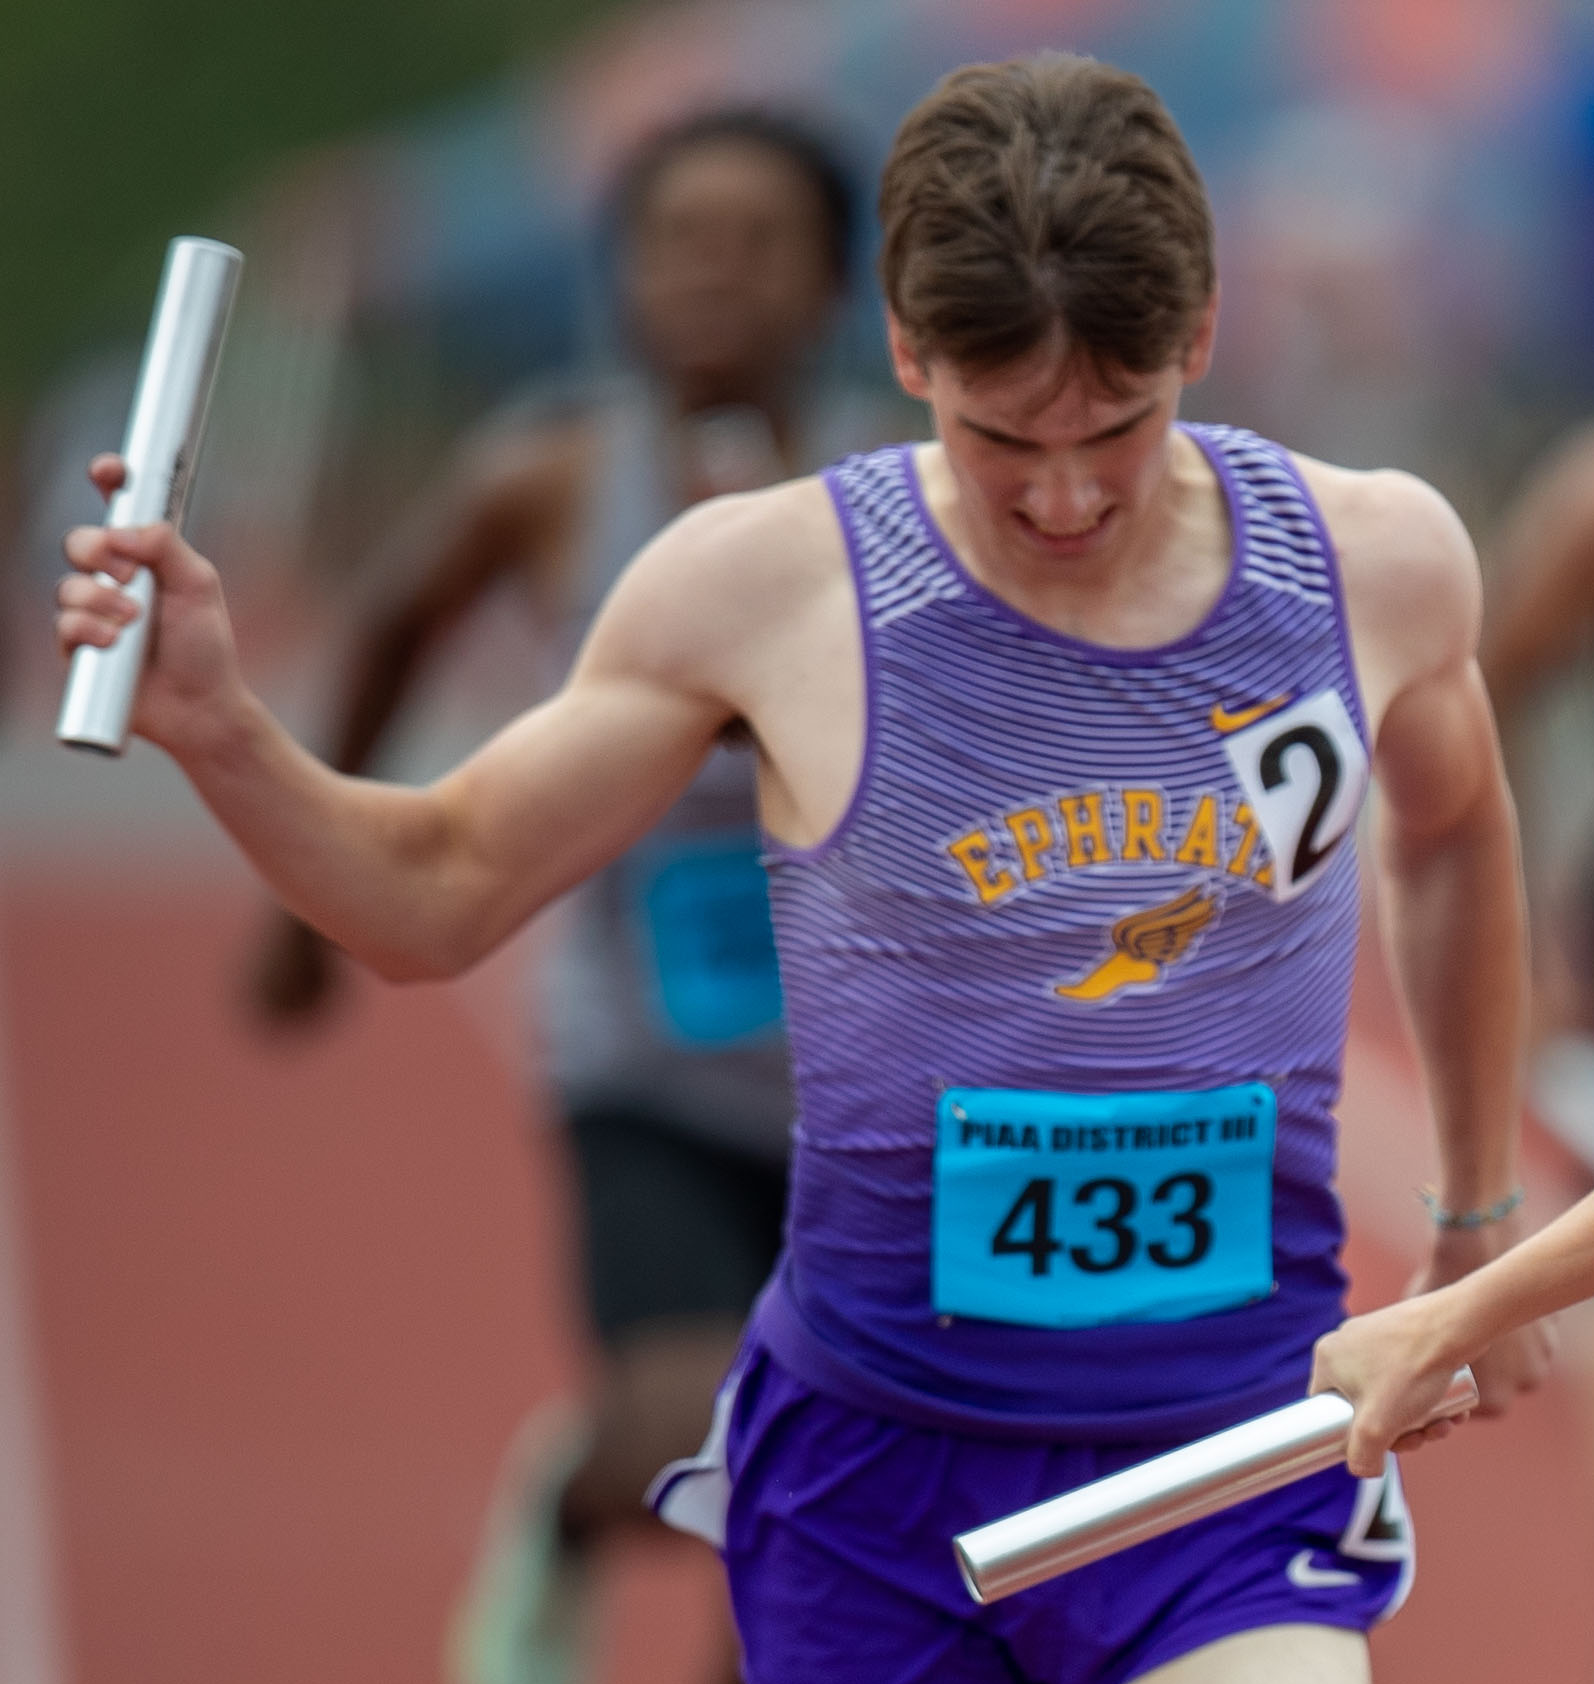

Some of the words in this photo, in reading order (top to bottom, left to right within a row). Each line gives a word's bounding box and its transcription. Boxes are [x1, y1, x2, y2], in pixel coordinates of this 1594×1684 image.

[947, 789, 1275, 905] EPHRAT
[1260, 725, 1350, 884] 2
[960, 1121, 1039, 1150] PIAA
[1052, 1119, 1213, 1151] DISTRICT
[1220, 1115, 1257, 1142] III
[991, 1171, 1215, 1278] 433
